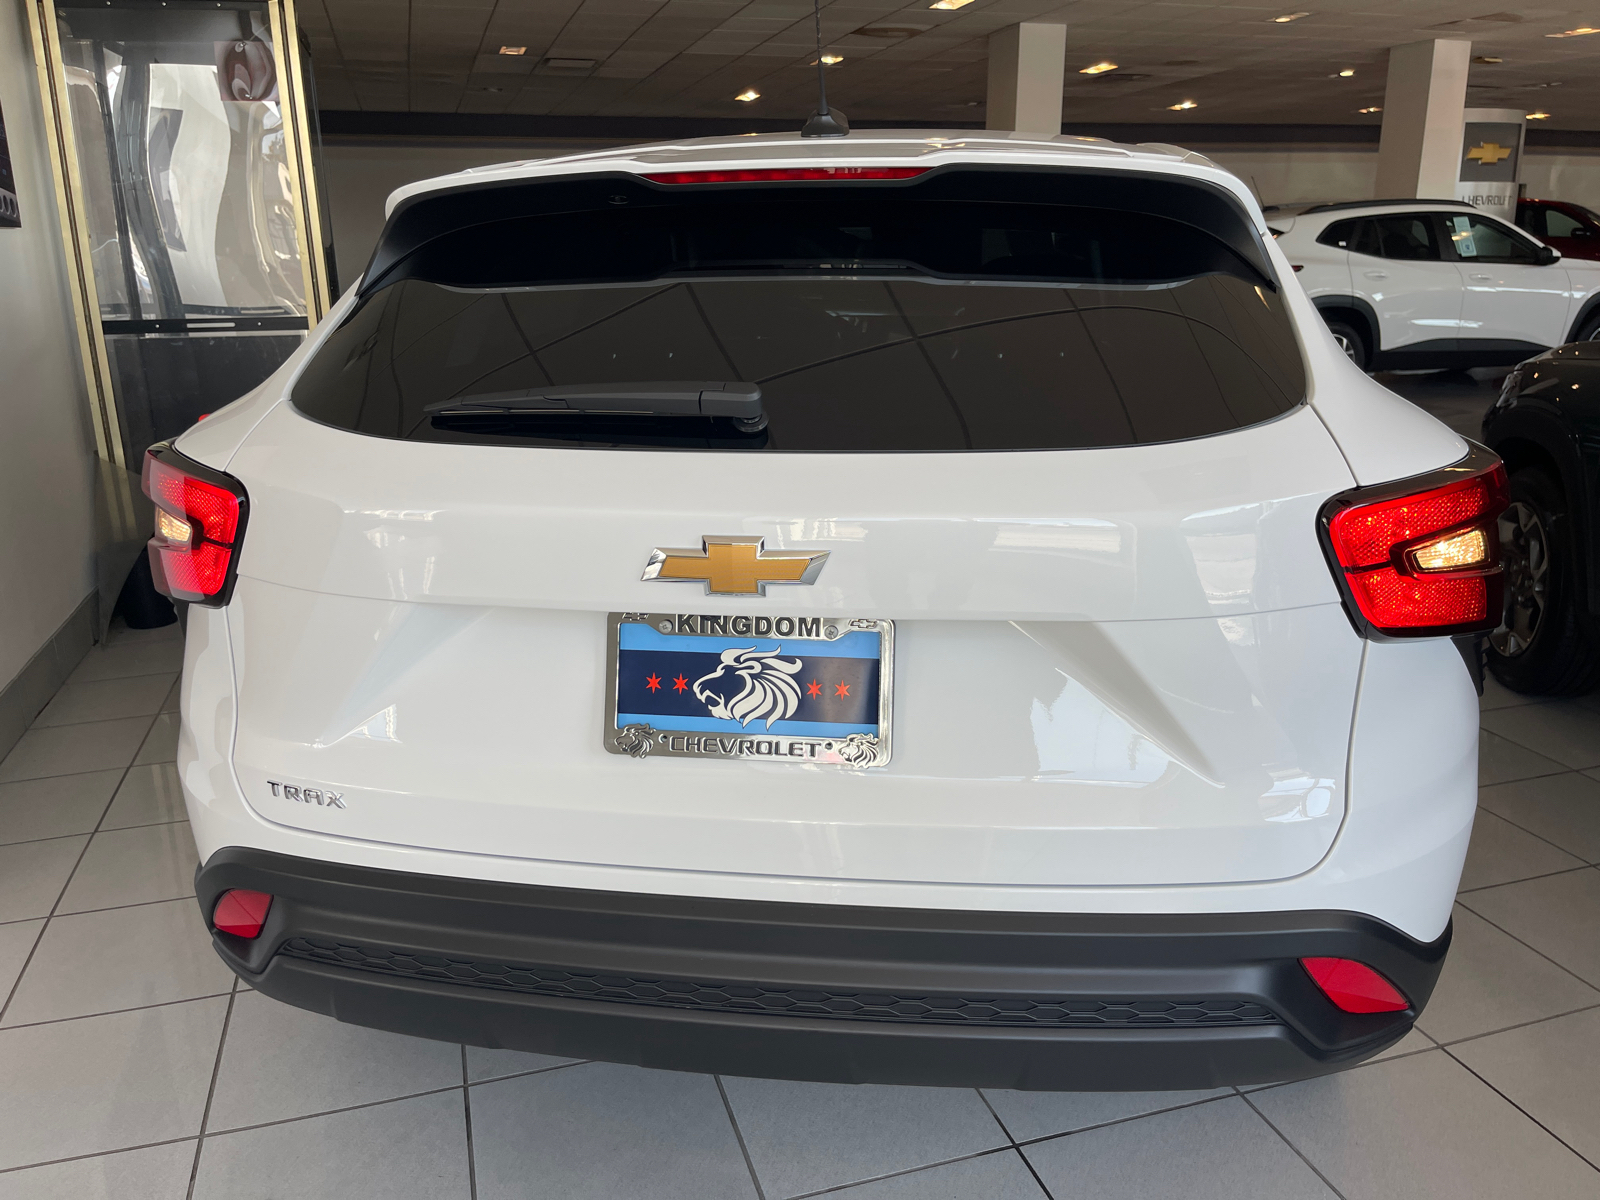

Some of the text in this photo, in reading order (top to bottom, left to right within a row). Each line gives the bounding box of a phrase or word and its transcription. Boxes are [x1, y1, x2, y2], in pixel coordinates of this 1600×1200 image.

[676, 614, 823, 638] KINGDOM
[669, 735, 821, 757] CHEVROLET
[267, 780, 347, 809] TRAX
